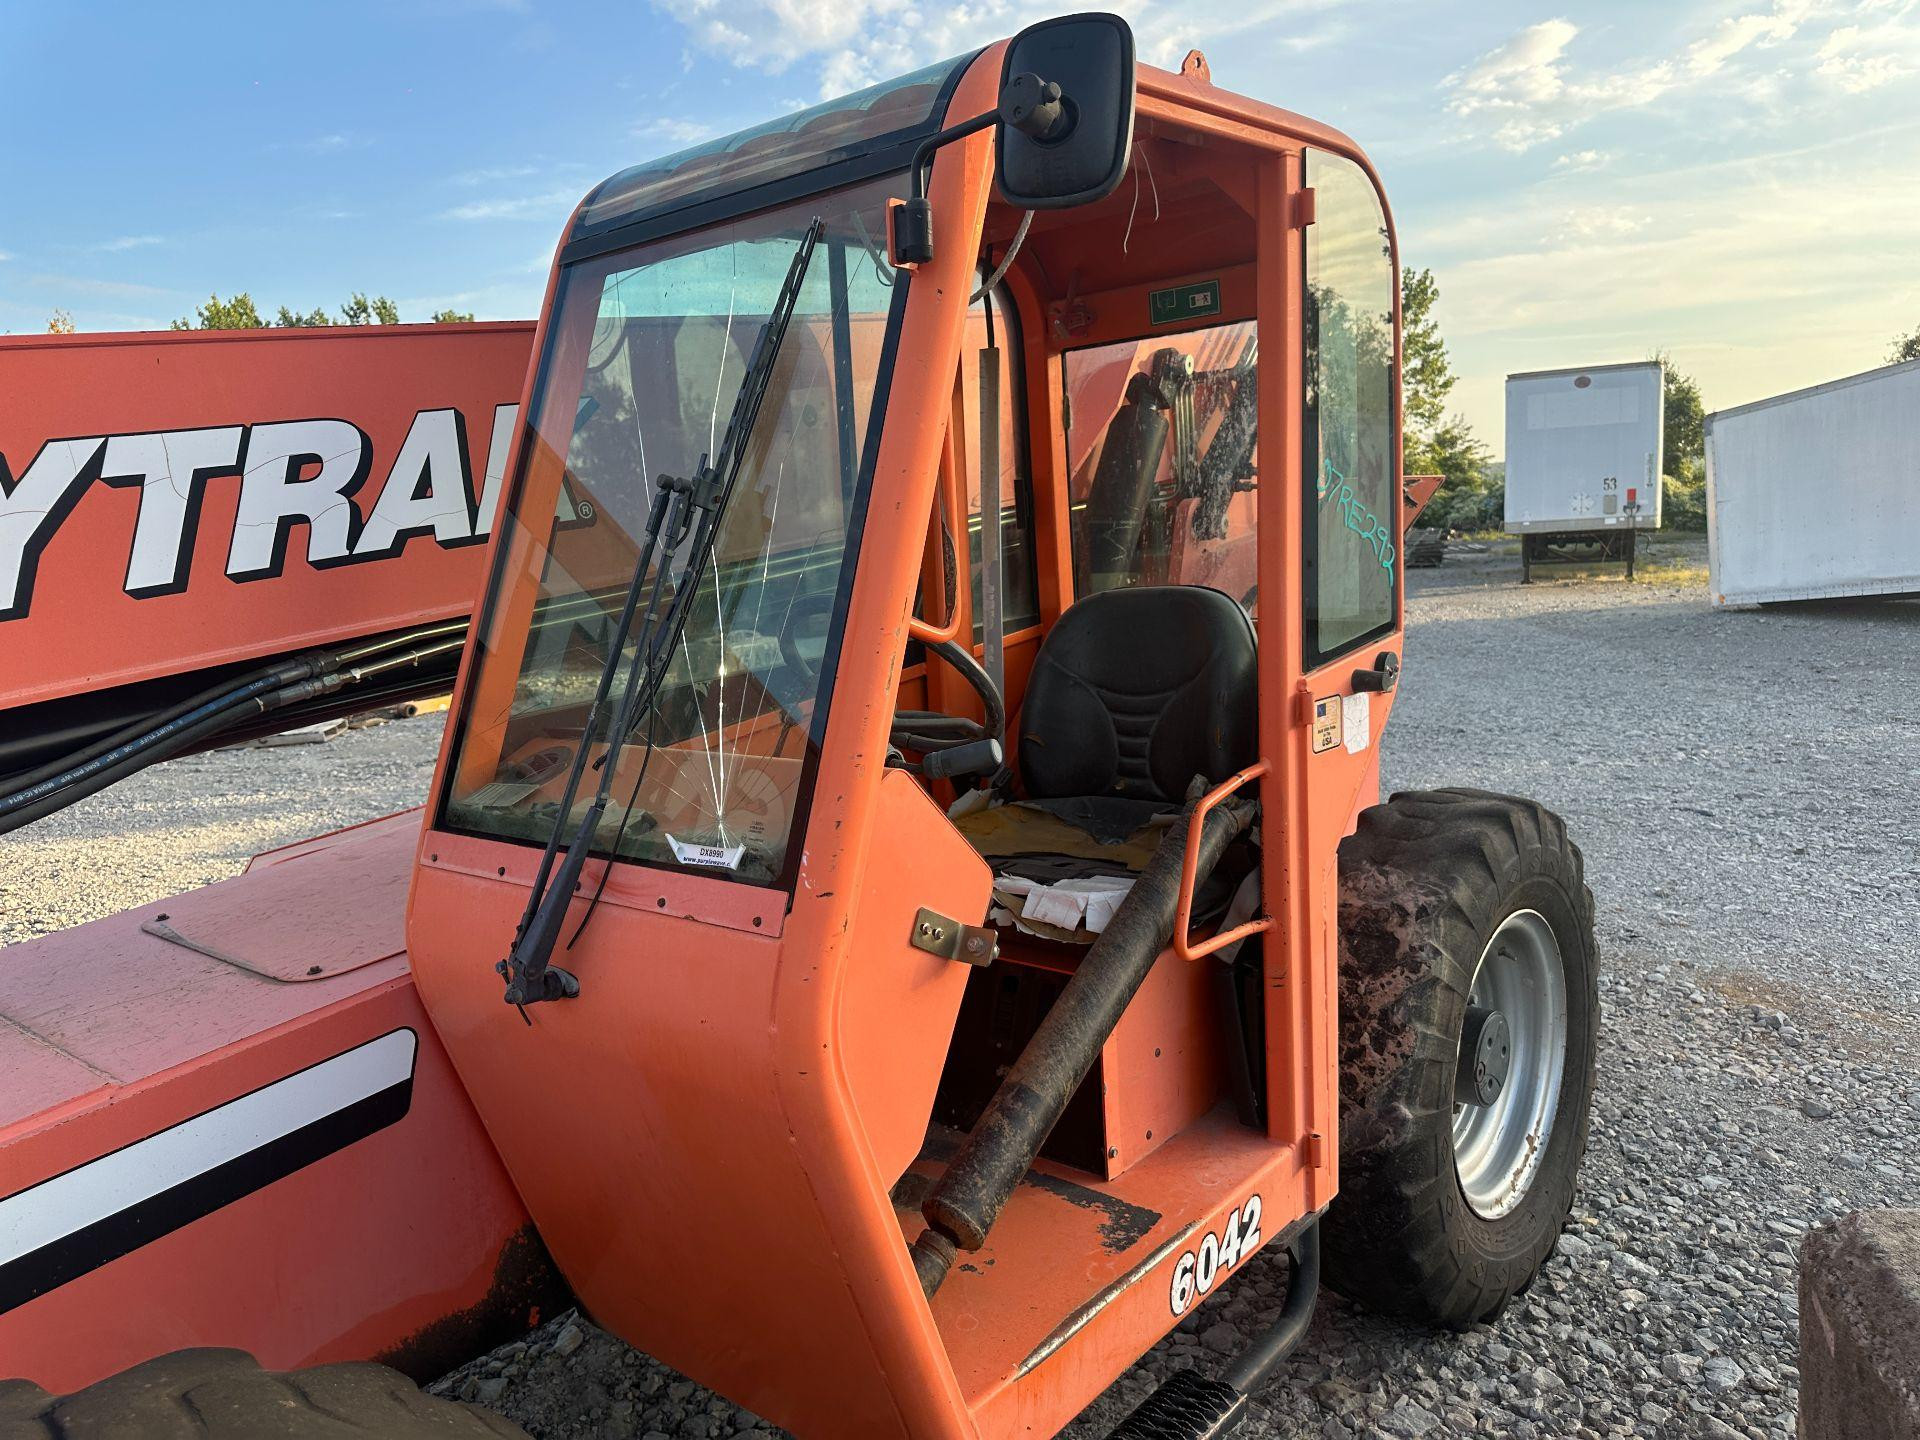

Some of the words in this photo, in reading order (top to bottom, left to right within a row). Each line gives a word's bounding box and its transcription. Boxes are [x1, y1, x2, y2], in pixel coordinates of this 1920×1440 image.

[1602, 477, 1617, 491] 53
[33, 782, 55, 794] MSHA
[1169, 1193, 1262, 1318] 6042
